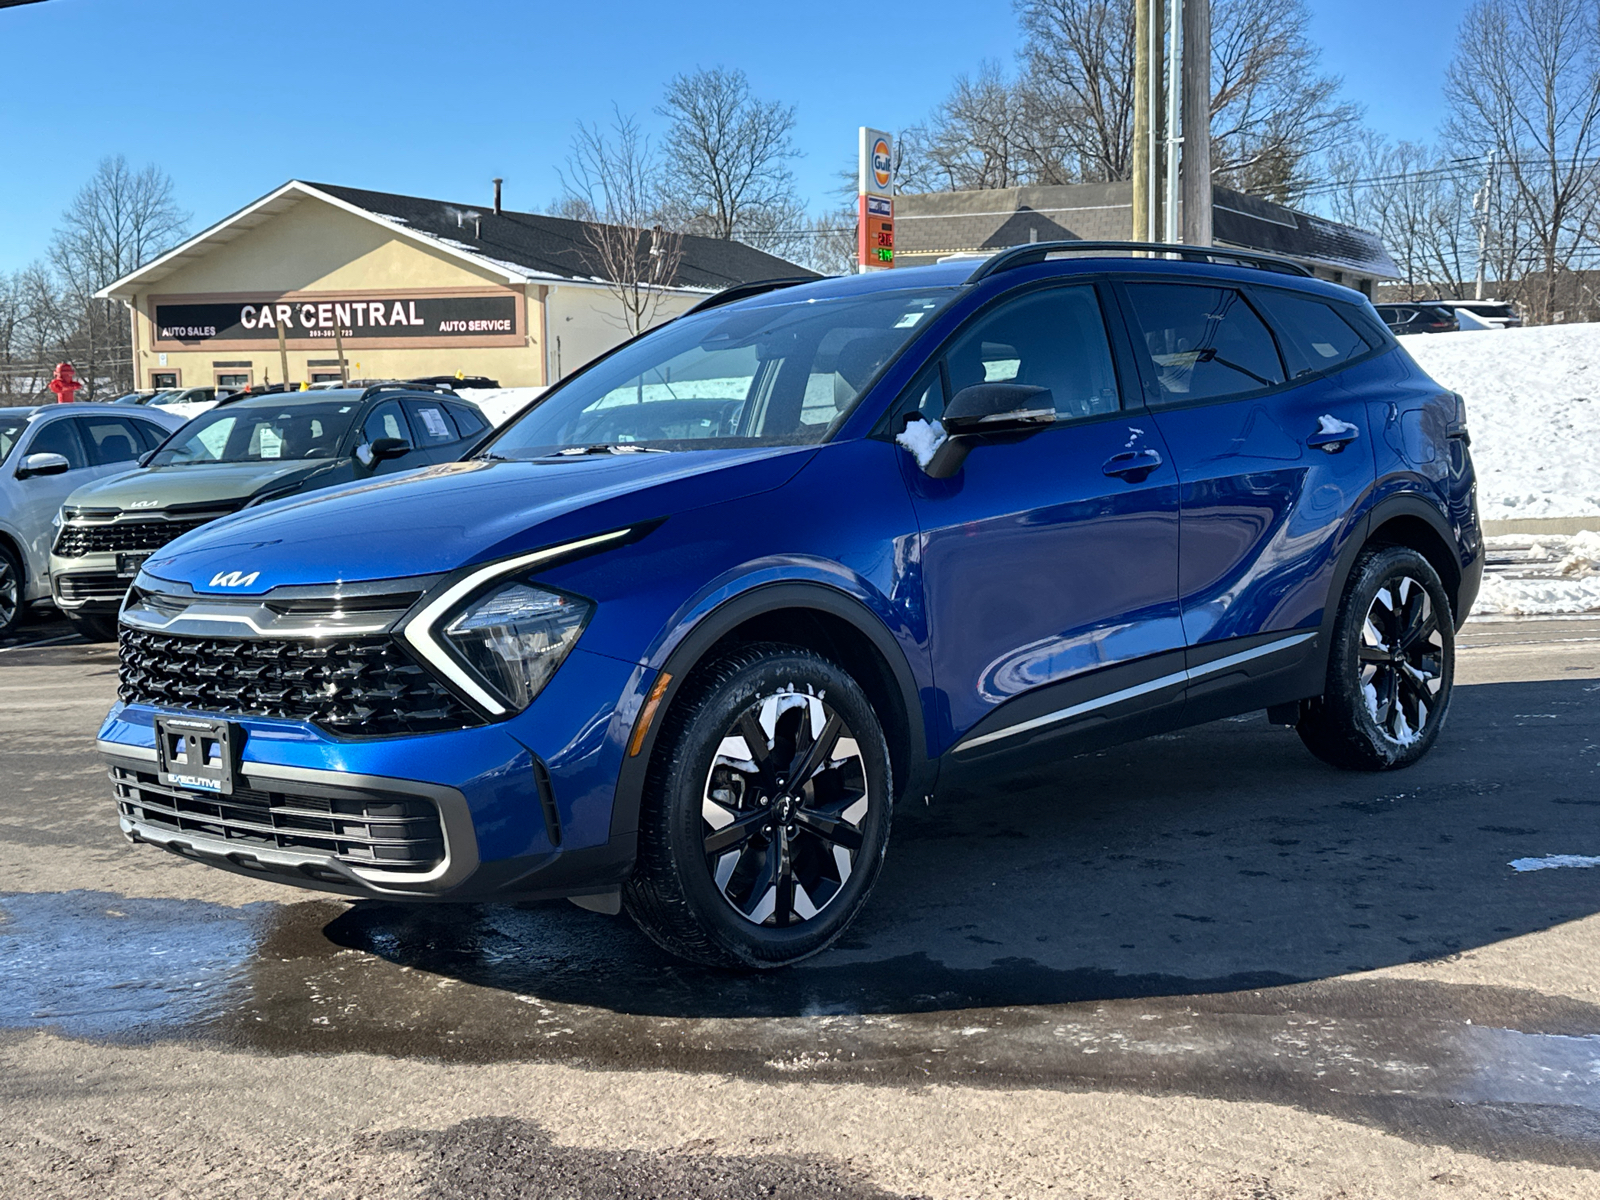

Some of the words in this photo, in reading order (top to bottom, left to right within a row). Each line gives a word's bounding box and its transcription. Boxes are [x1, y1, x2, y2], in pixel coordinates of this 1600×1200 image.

[875, 154, 891, 172] Gulf
[241, 304, 293, 328] CAR
[300, 301, 424, 328] CENTRAL
[162, 327, 187, 337] AUTO
[187, 326, 216, 337] SALES
[439, 320, 467, 332] AUTO
[468, 319, 511, 331] SERVICE
[168, 774, 221, 789] EXECUTIVE
